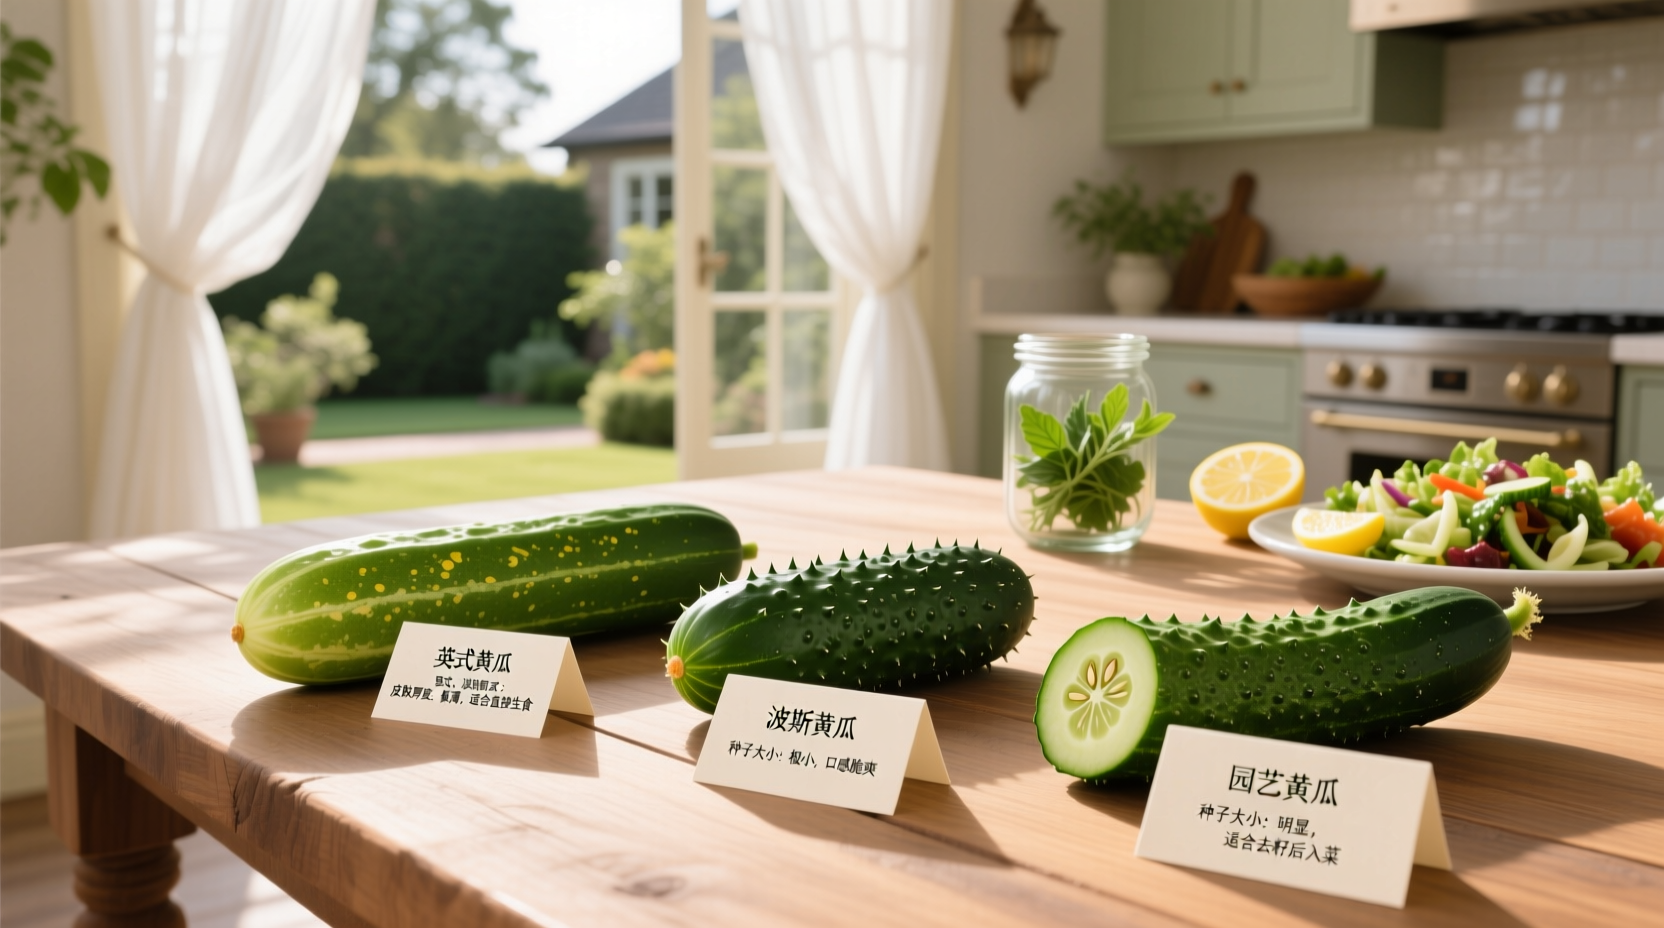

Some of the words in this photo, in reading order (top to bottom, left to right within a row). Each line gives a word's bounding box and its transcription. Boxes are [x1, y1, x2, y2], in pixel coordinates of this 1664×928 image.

[433, 646, 512, 673] 英式黄瓜
[766, 705, 857, 740] 波斯黄瓜
[1228, 764, 1339, 806] 园艺黄瓜
